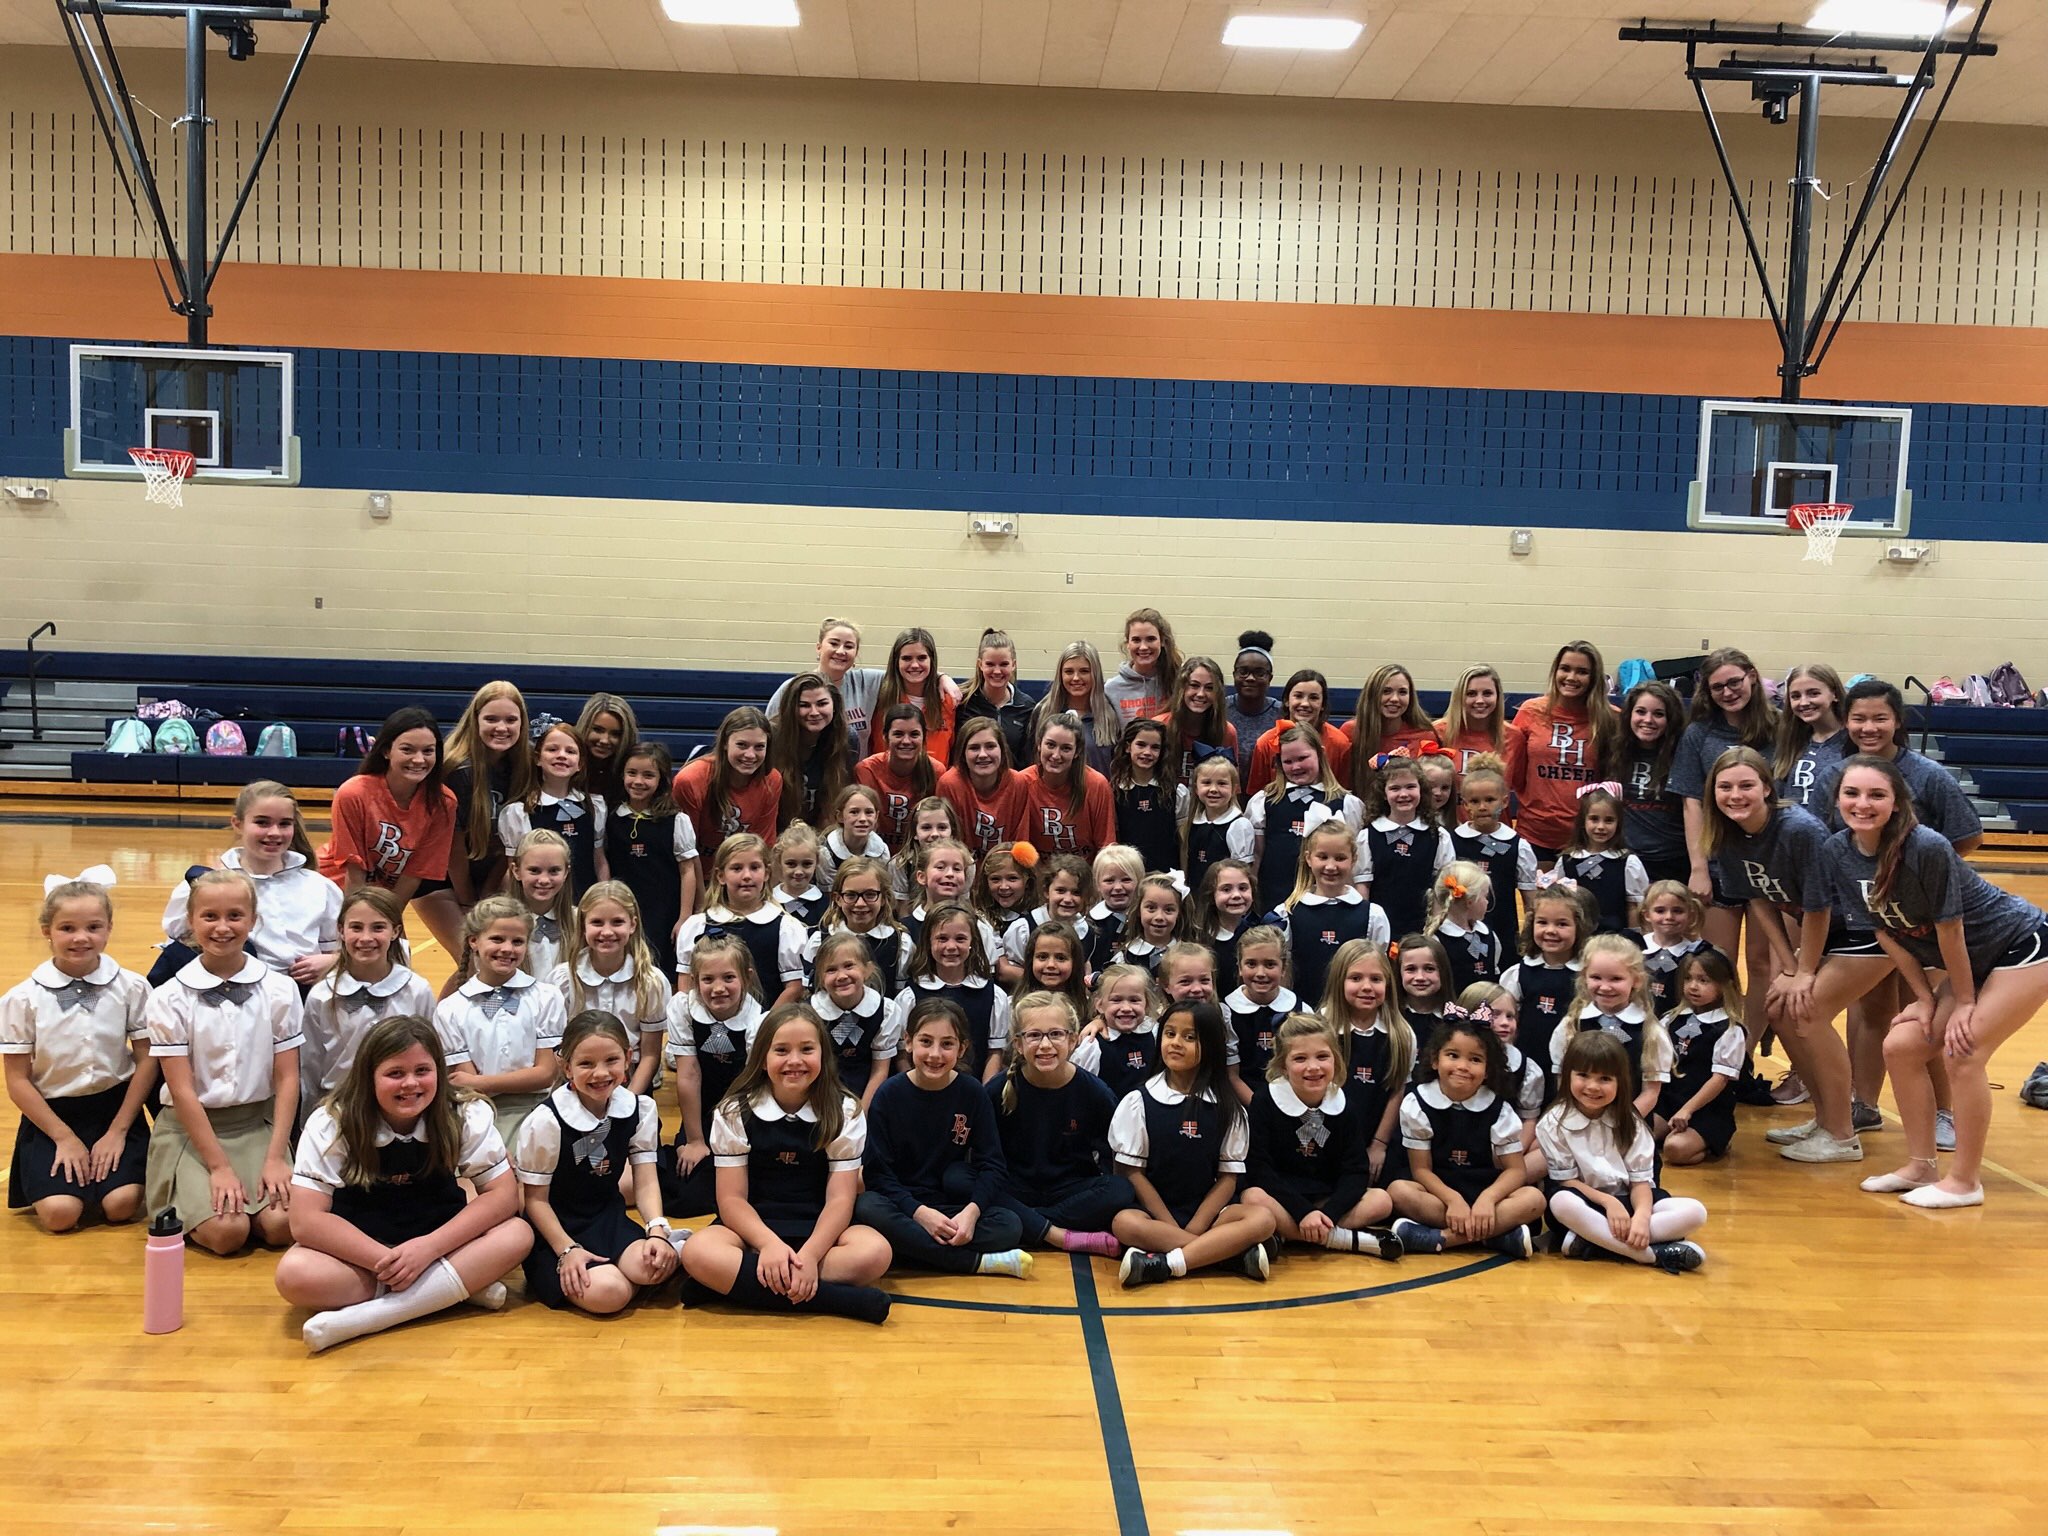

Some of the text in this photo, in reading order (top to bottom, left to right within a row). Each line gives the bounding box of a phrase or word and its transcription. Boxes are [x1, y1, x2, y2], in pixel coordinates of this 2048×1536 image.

[1548, 722, 1587, 767] BH
[1537, 765, 1595, 781] CHEER
[368, 820, 416, 876] BH
[1041, 807, 1079, 850] BH
[1742, 859, 1792, 903] BH
